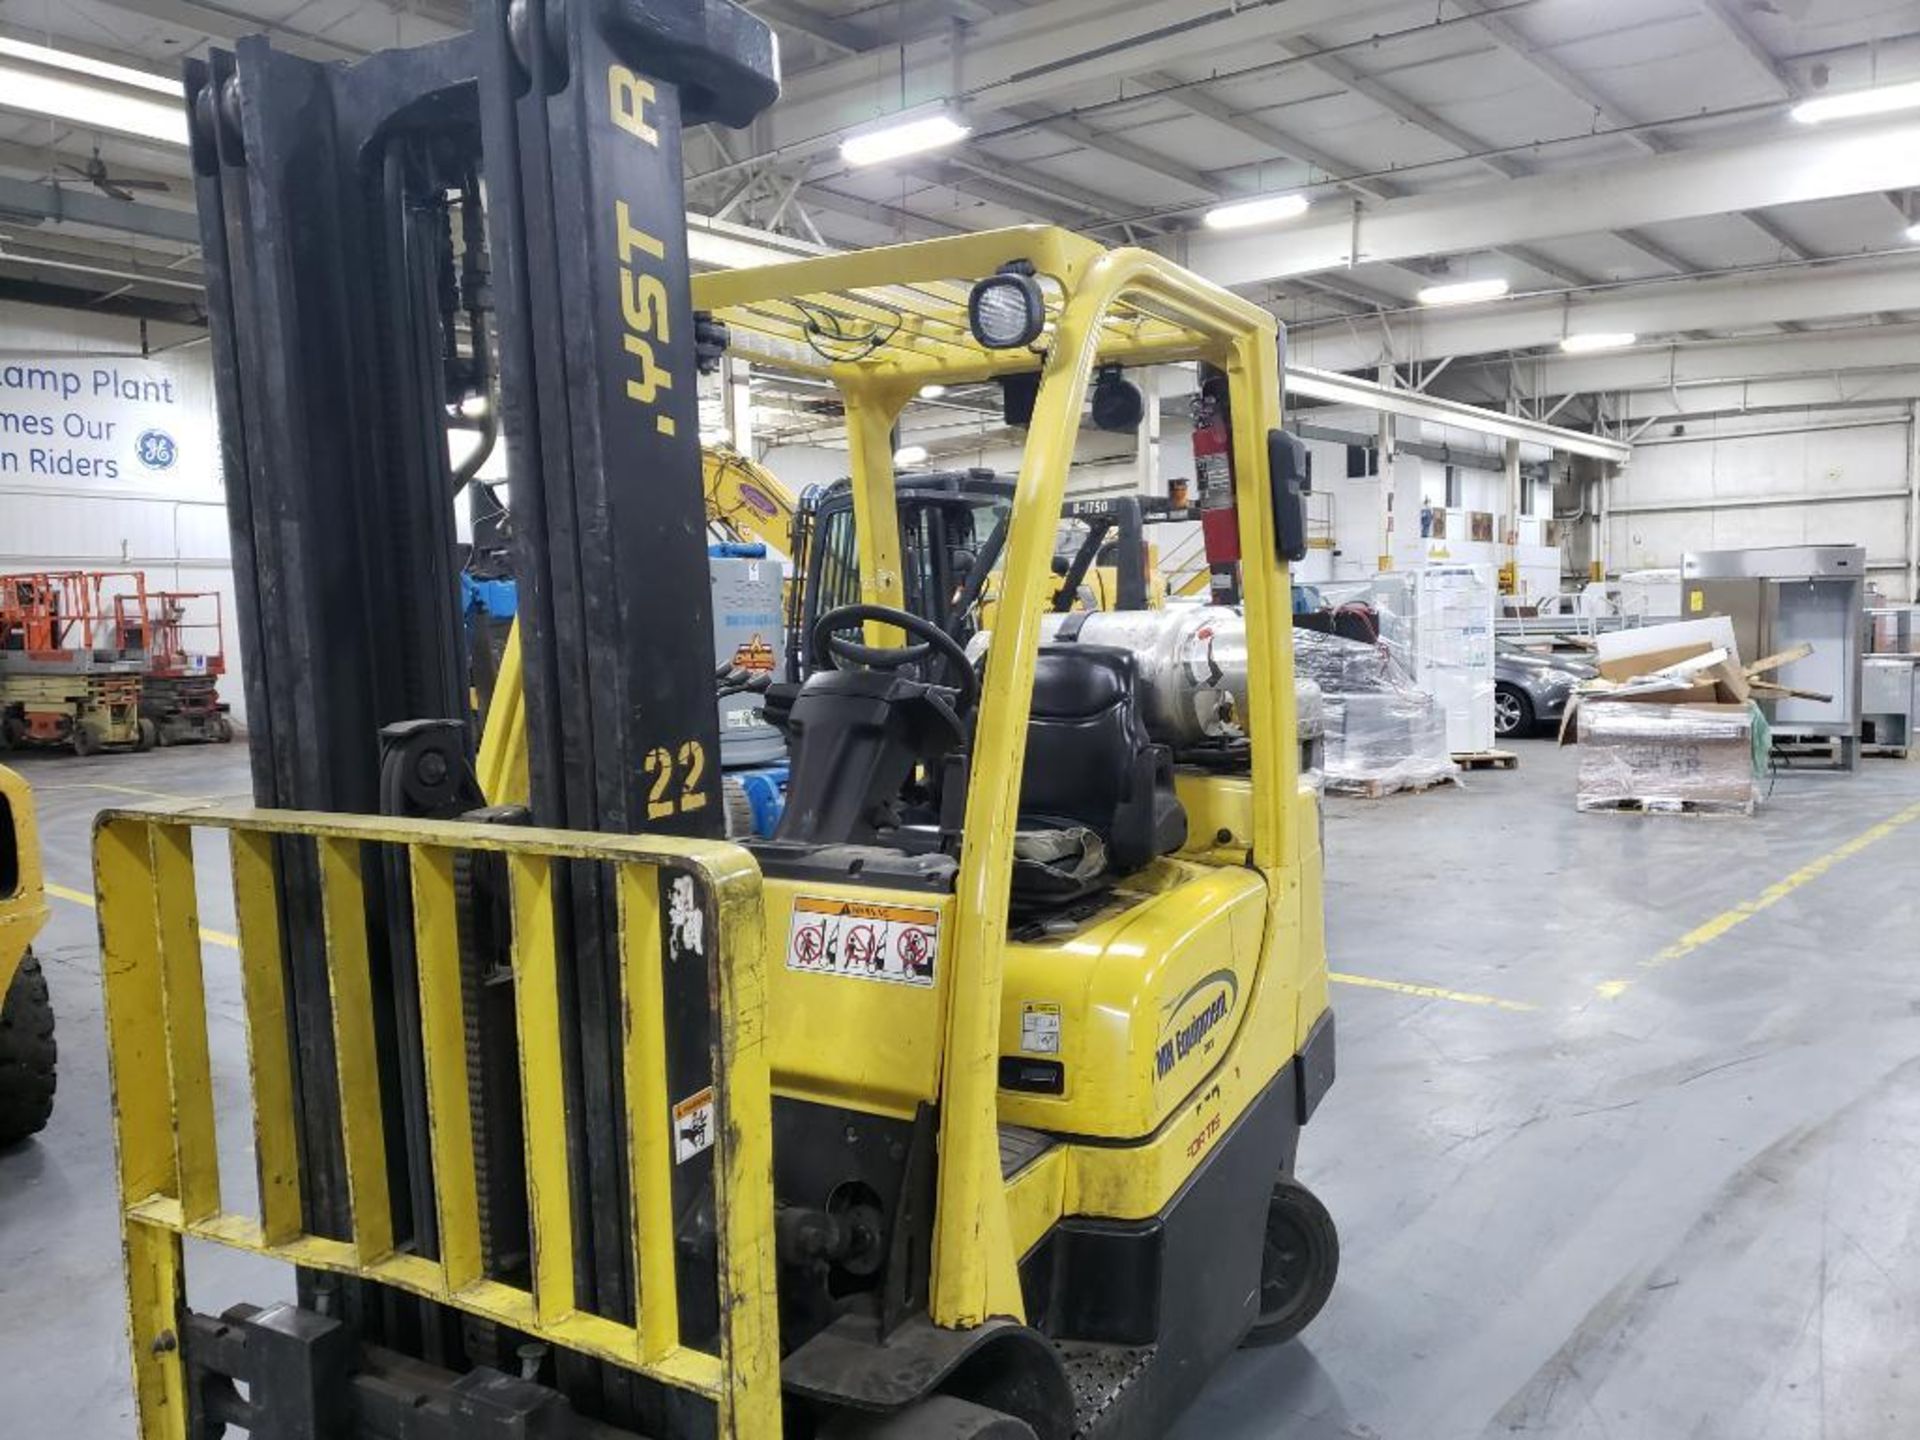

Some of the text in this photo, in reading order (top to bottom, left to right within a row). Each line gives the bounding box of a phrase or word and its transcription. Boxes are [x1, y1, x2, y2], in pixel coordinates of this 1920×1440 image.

[0, 365, 174, 403] amp Plant
[63, 413, 116, 441] Our
[30, 449, 118, 478] Riders
[644, 740, 707, 820] 22
